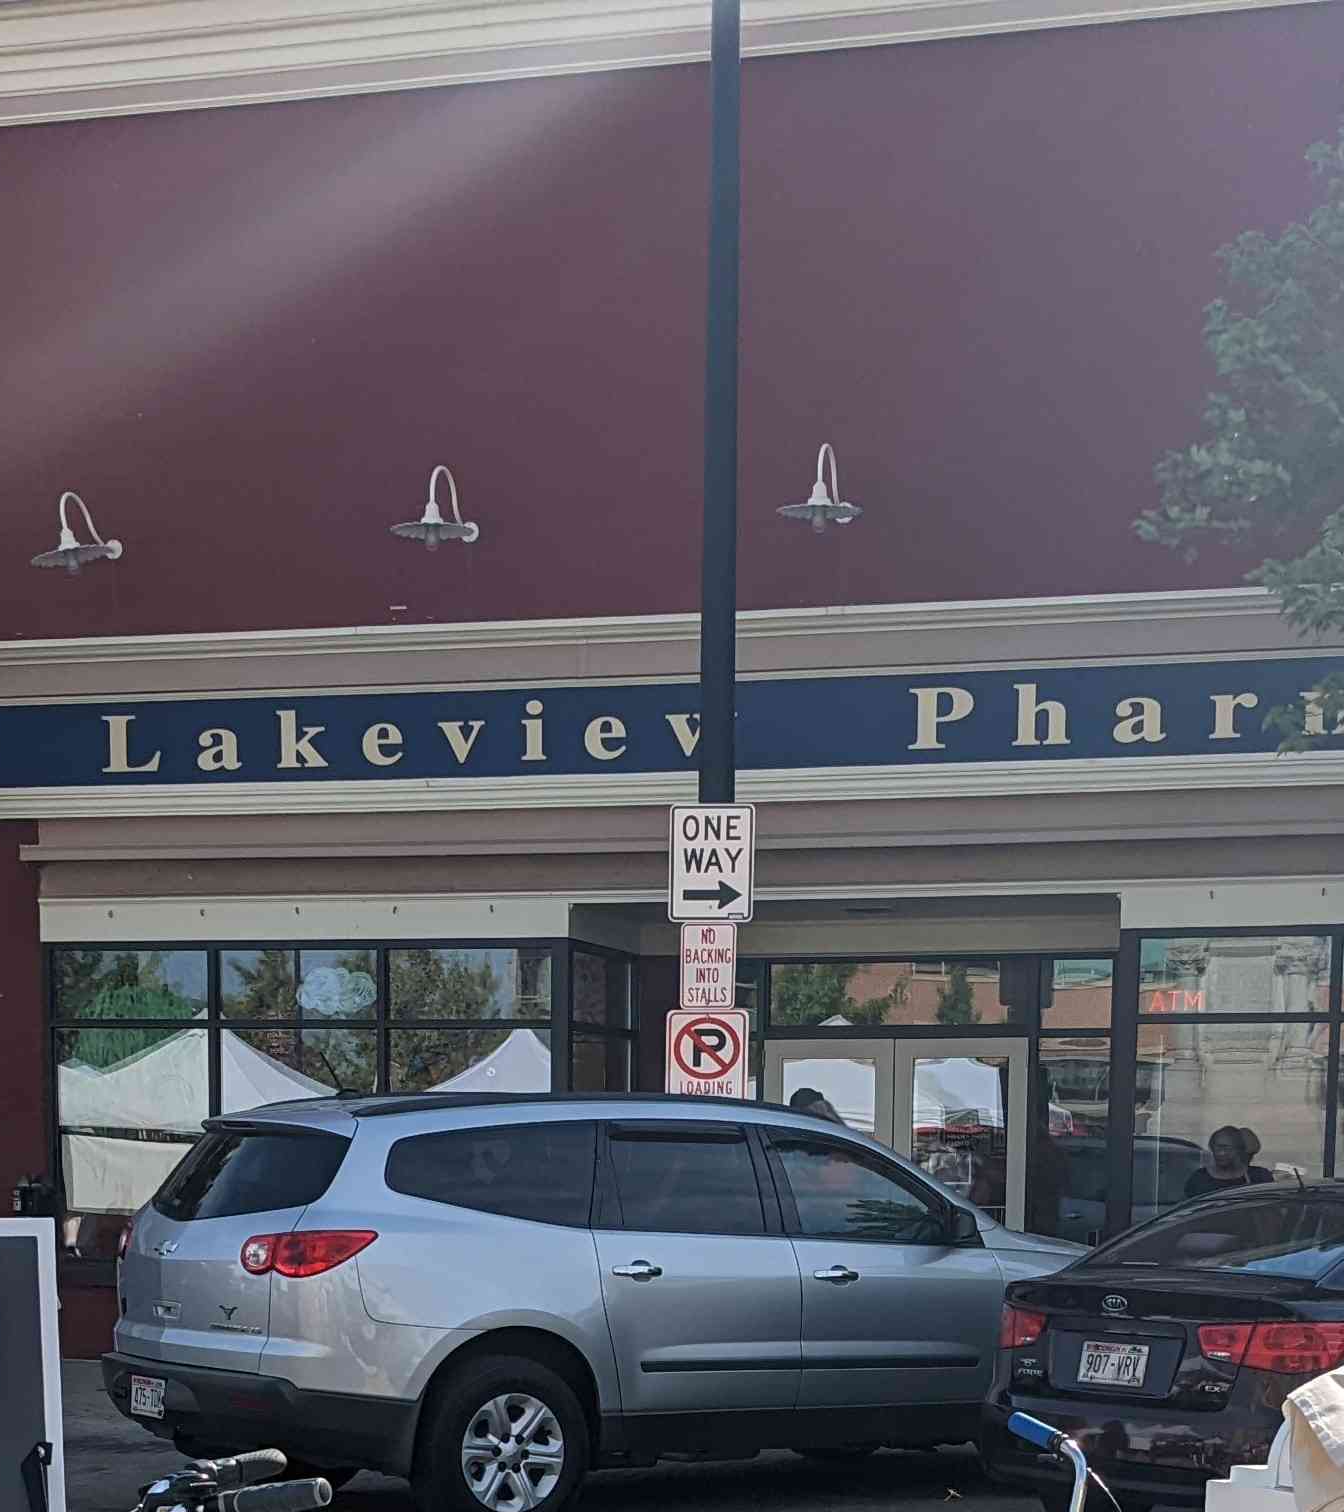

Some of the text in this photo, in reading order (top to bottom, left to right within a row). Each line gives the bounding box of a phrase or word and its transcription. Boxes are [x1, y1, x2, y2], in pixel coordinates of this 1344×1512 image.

[682, 815, 742, 841] ONE
[683, 848, 744, 873] WAY
[701, 928, 716, 944] NO
[685, 948, 732, 964] BACKING
[695, 967, 719, 983] INTO
[687, 987, 727, 1003] STALLS
[1148, 990, 1205, 1012] ATM
[680, 1080, 733, 1095] LOADING
